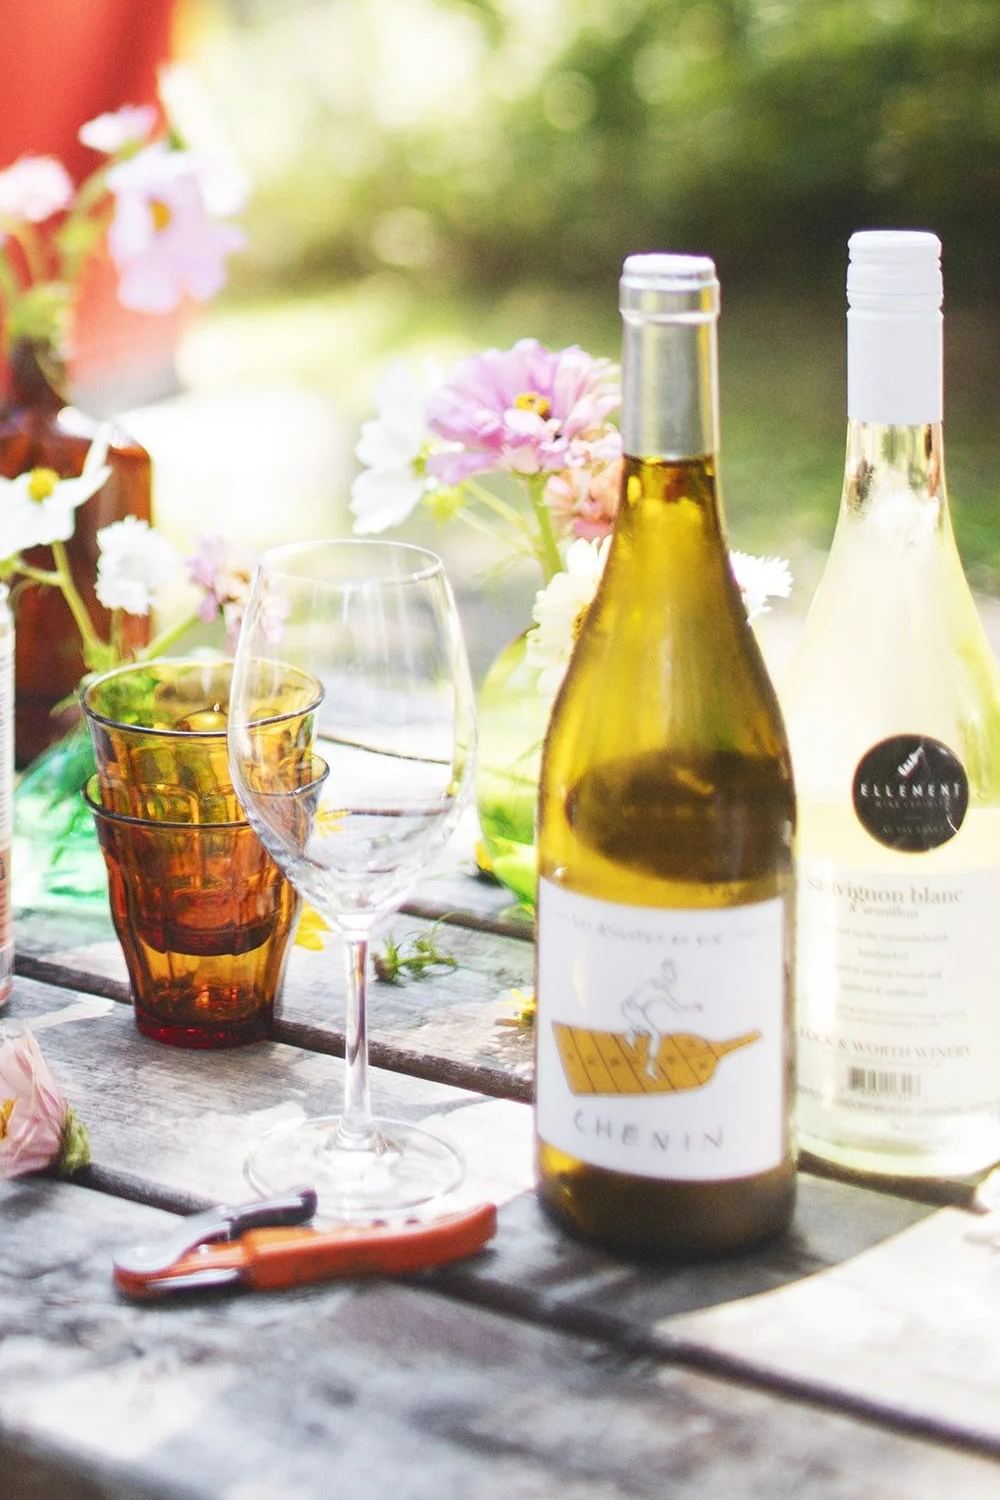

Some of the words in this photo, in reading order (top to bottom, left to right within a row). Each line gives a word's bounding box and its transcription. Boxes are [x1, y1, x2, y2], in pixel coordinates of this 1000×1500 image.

[859, 782, 961, 799] ELLEMENT
[909, 884, 964, 905] blanc
[837, 1037, 850, 1052] &
[851, 1040, 912, 1059] WORTH
[914, 1045, 972, 1060] WINERY
[573, 1107, 723, 1154] CHENIN
